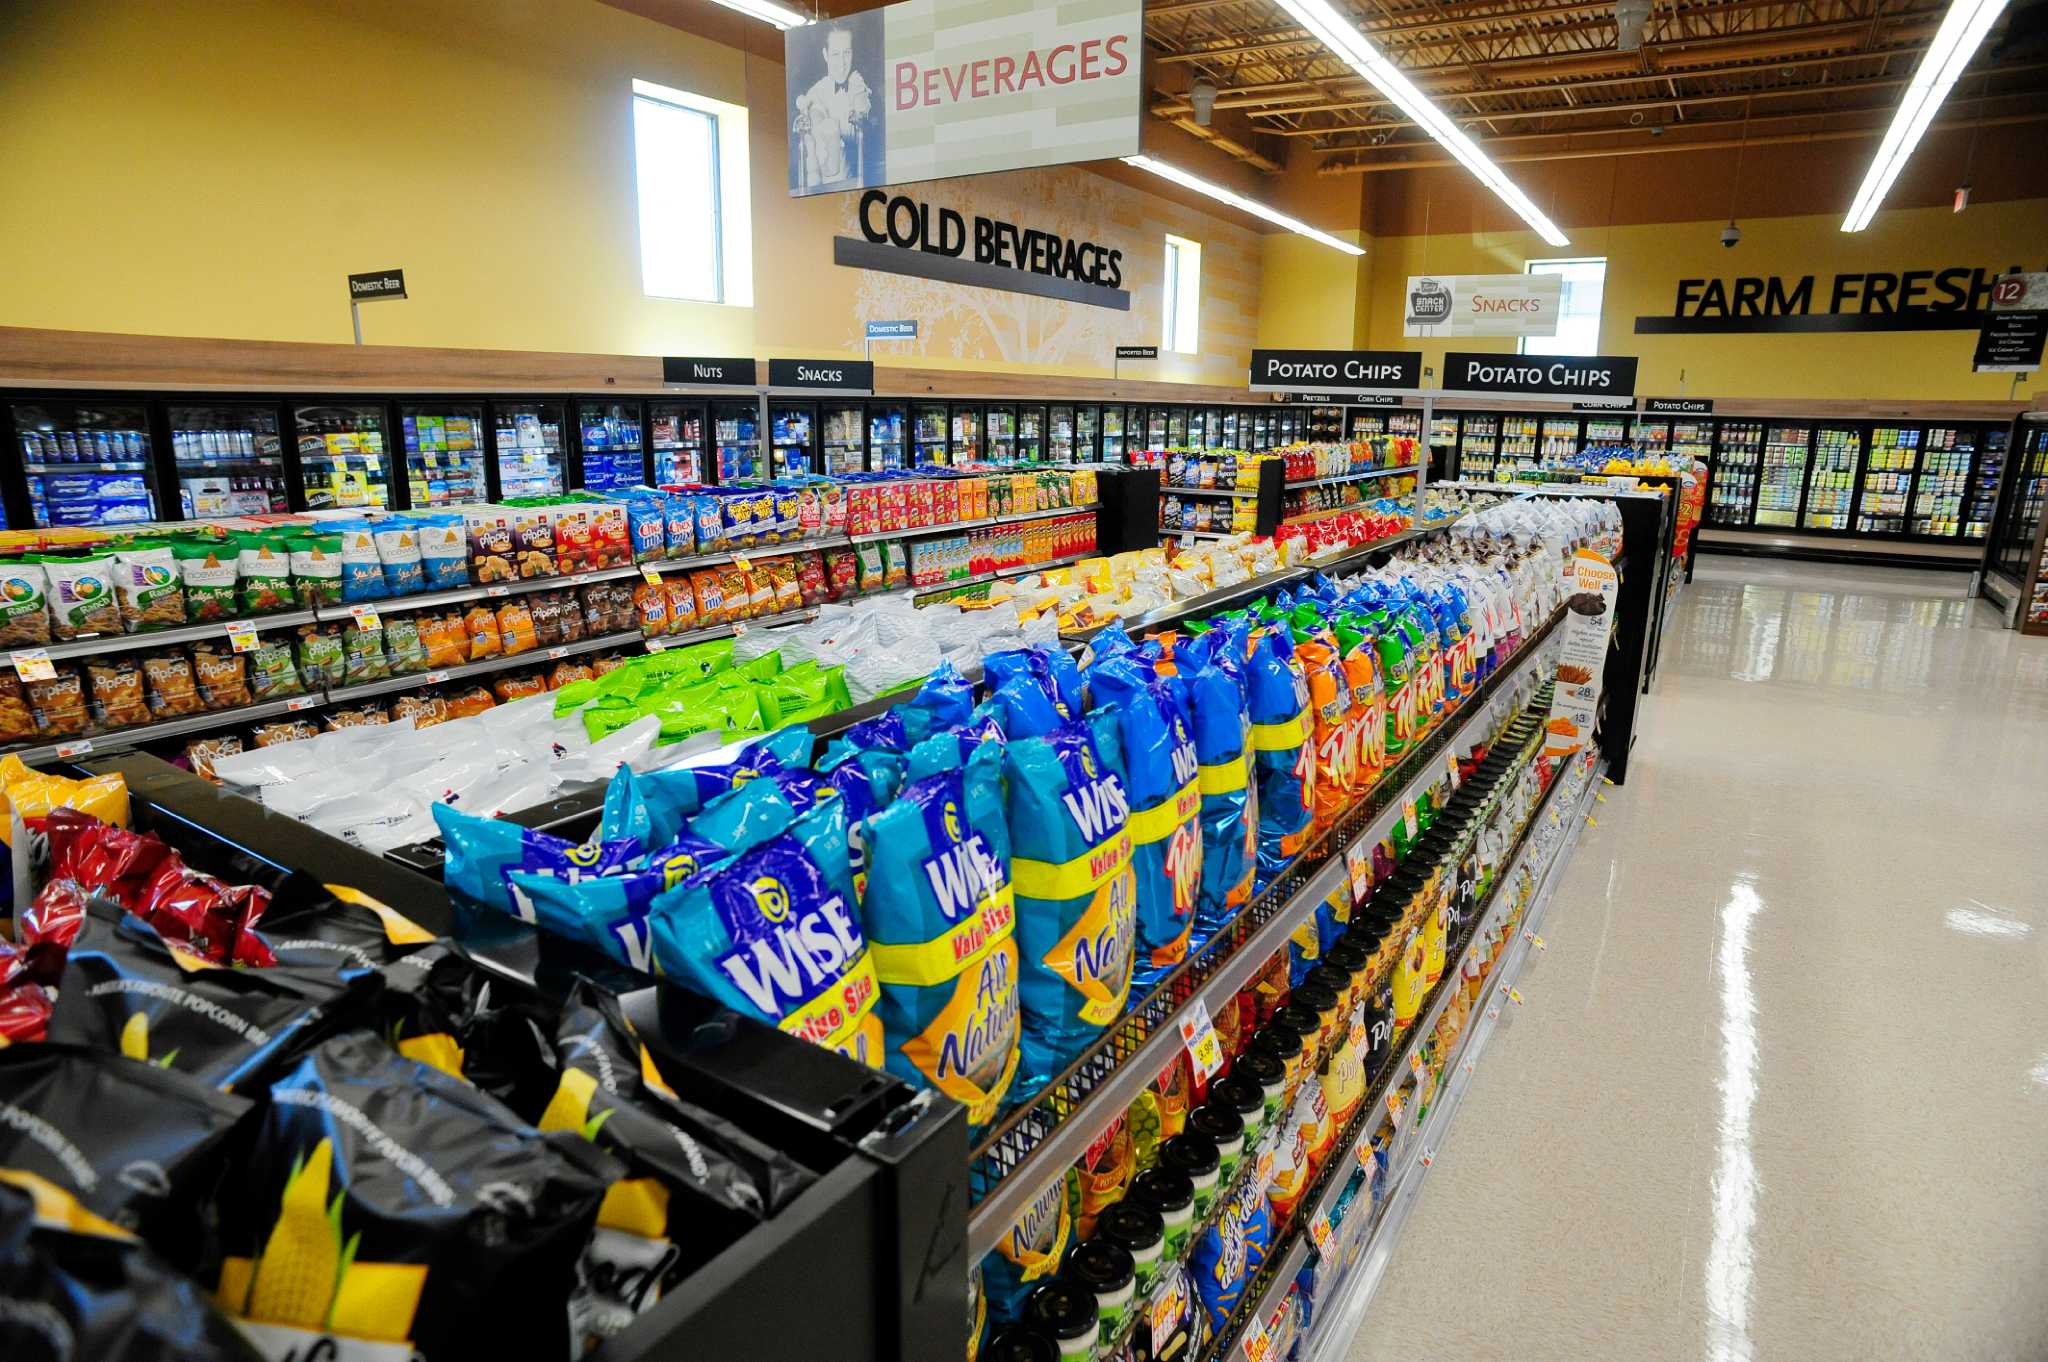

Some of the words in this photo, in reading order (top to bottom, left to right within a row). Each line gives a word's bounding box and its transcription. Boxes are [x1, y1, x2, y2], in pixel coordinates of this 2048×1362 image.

[894, 34, 1129, 111] BEVERAGES
[858, 190, 966, 259] COLD
[974, 216, 1124, 289] BEVERAGES
[352, 280, 384, 292] DOMESTIC
[1999, 283, 2021, 300] 12
[1416, 297, 1444, 305] SNACK
[1472, 295, 1541, 312] SNACKS
[1675, 275, 1814, 317] FARM
[1415, 305, 1444, 313] CENTER
[693, 364, 723, 378] NUTS
[797, 366, 843, 382] SNACKS
[1267, 359, 1338, 379] POTATO
[1344, 360, 1402, 380] CHIPS
[1467, 361, 1543, 385] POTATO
[1548, 363, 1612, 387] CHIPS
[1303, 394, 1331, 402] PRETZELS
[1357, 395, 1375, 403] CORN
[1375, 396, 1394, 404] CHIPS
[1653, 400, 1681, 410] POTATO
[1682, 401, 1706, 412] CHIPS
[1577, 566, 1616, 581] Choose
[149, 584, 177, 598] Ranch
[1579, 577, 1602, 591] Well
[7, 601, 40, 616] Ranch
[80, 596, 111, 614] Ranch
[1578, 686, 1591, 697] 28
[1089, 852, 1118, 881] Value
[952, 926, 984, 961] Valu
[981, 902, 1012, 937] Size
[721, 895, 863, 1014] WISE
[976, 950, 1010, 1011] All
[843, 975, 872, 1016] Size
[182, 991, 246, 1035] POPCORN
